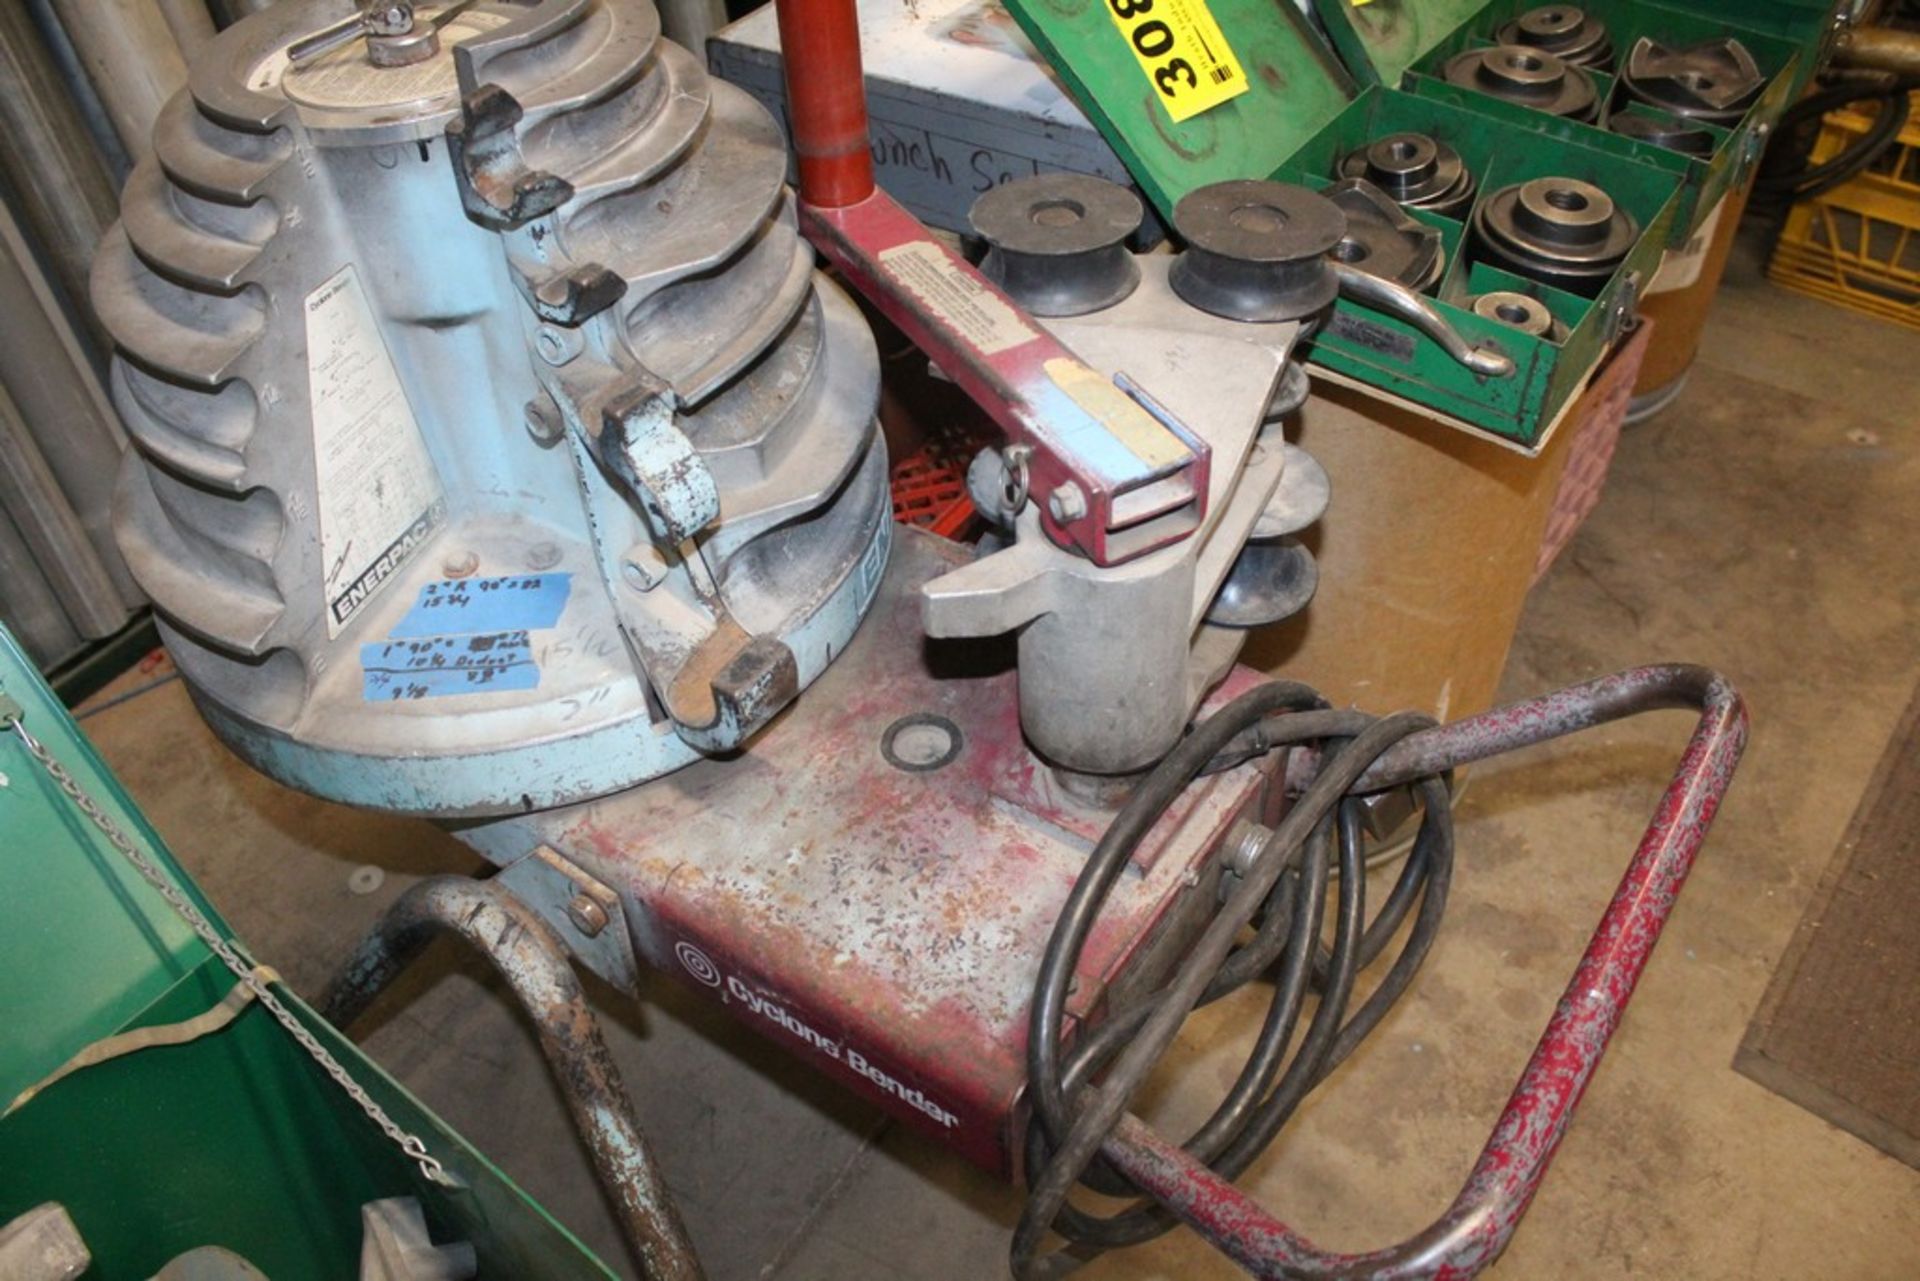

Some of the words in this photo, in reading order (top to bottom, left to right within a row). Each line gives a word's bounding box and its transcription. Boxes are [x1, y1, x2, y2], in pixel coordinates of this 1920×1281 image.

[1110, 0, 1197, 98] 308
[335, 519, 429, 620] ENERPAC
[726, 975, 841, 1059] Cyclone
[846, 1048, 960, 1129] Bender
